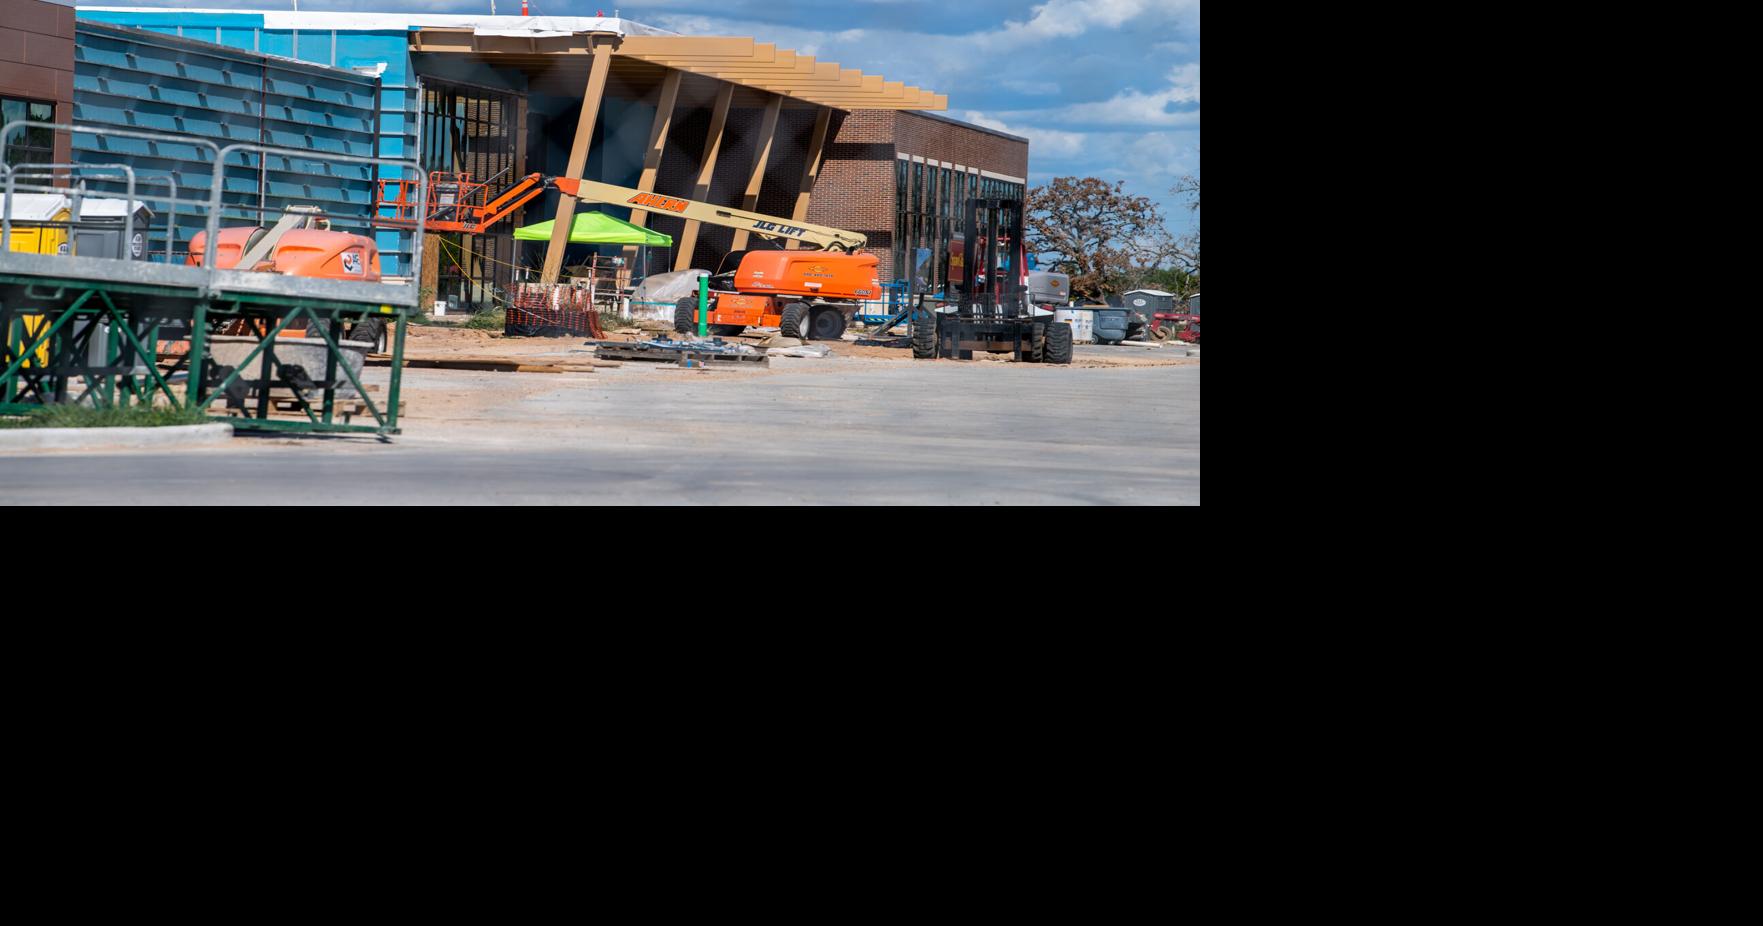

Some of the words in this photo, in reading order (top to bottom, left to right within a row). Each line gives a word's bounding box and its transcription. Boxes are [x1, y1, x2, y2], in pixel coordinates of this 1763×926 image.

[628, 192, 690, 213] AHERN
[752, 220, 775, 232] JLG
[777, 224, 807, 237] LIFT
